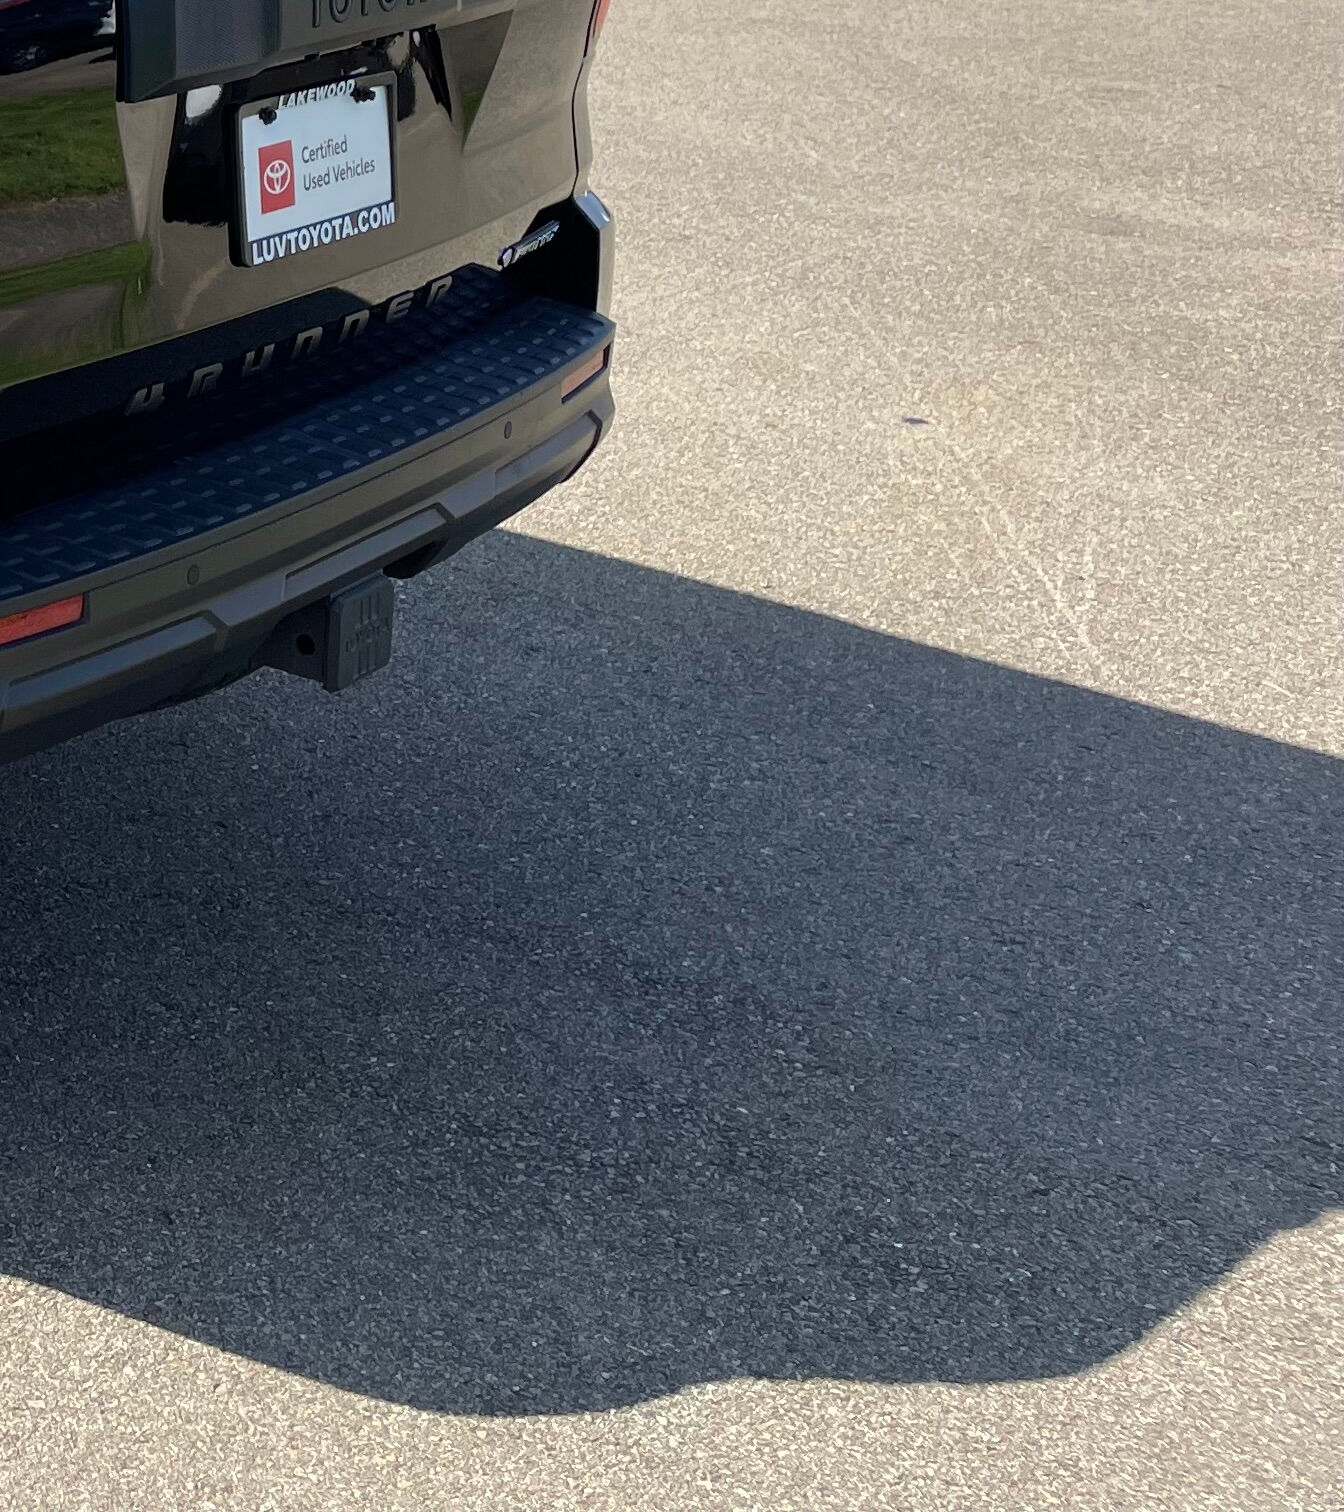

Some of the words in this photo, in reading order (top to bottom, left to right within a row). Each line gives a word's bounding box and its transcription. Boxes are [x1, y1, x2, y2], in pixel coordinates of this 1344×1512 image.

[278, 79, 356, 110] LAKEWOOD
[301, 135, 348, 164] Certified
[303, 168, 331, 192] Used
[333, 157, 376, 185] Vehicles
[252, 201, 395, 266] LUVTOYOTA.COM
